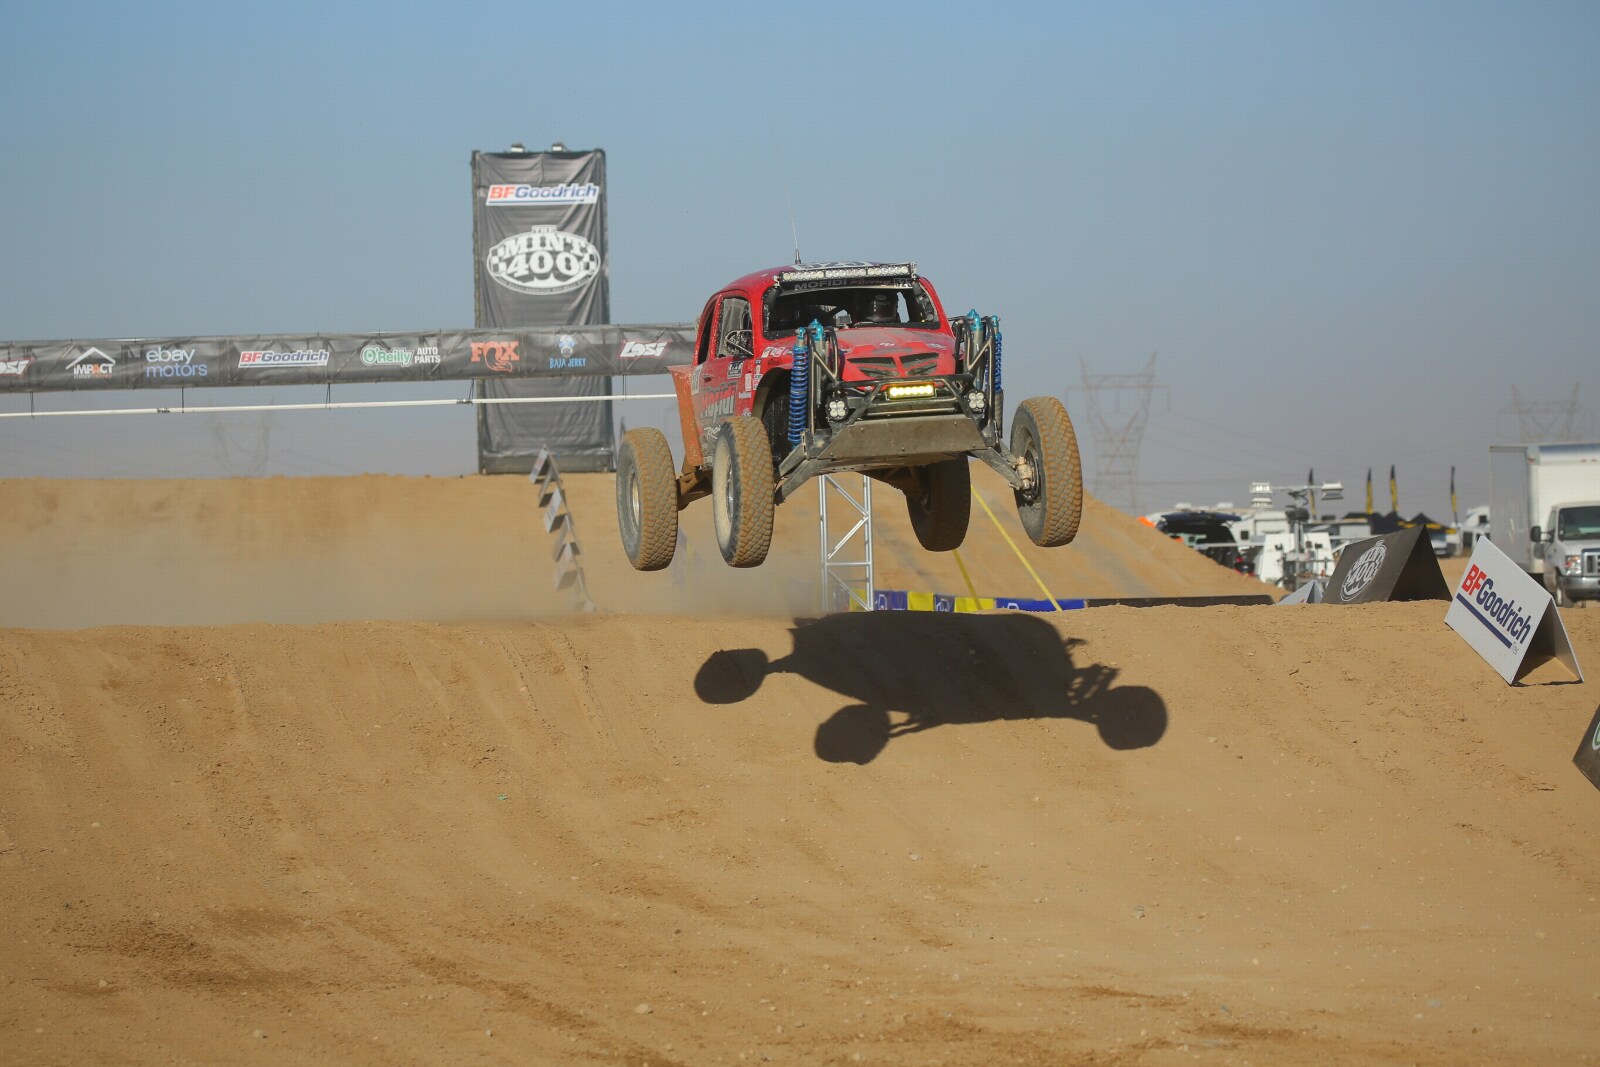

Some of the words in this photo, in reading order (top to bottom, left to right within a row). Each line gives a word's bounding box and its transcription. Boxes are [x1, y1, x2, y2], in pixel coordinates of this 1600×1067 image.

[489, 184, 598, 199] BFGoodrich
[503, 232, 588, 260] MINT
[506, 251, 580, 277] 400
[145, 346, 196, 364] ebay
[240, 351, 328, 362] BFGoodrich
[362, 346, 413, 365] O'Reilly
[416, 346, 439, 355] AUTO
[470, 340, 520, 371] FOX
[414, 355, 441, 364] PARTS
[549, 358, 566, 368] BAJA
[567, 358, 586, 367] JERKY
[145, 362, 208, 378] motors
[1461, 563, 1531, 644] BFGoodrich
